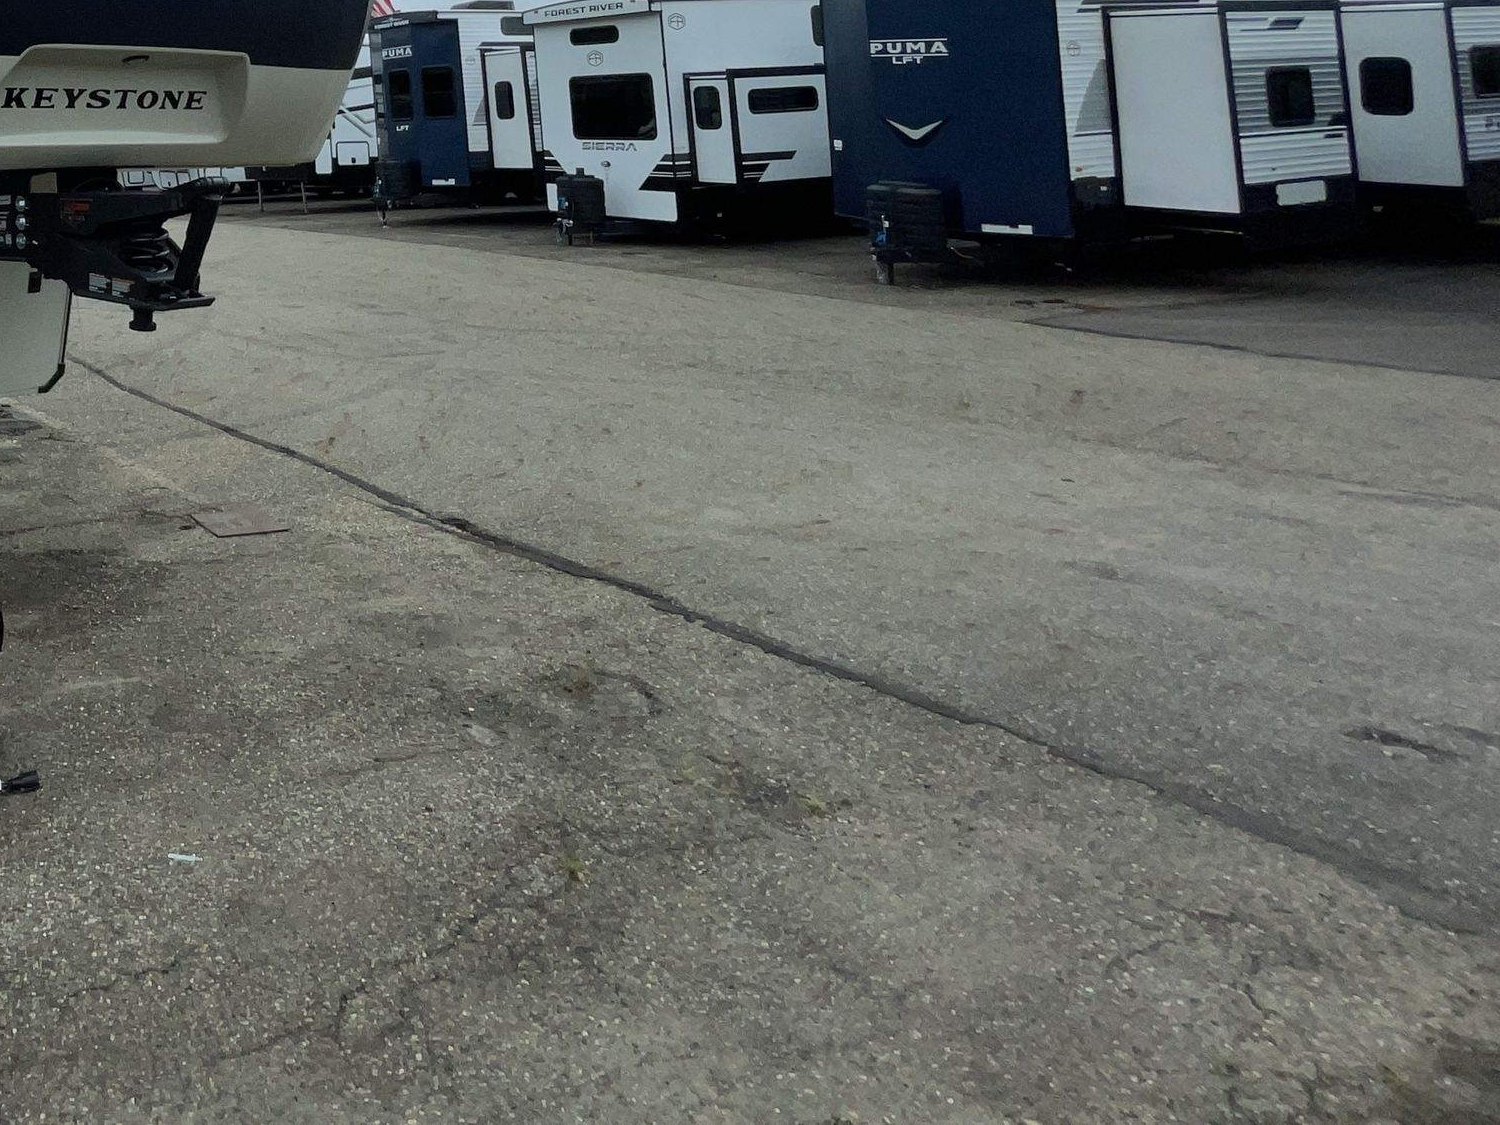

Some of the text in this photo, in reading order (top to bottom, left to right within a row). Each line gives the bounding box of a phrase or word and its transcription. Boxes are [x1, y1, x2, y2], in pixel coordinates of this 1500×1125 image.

[544, 2, 624, 17] FOREST RIVER
[382, 47, 412, 58] PUMA
[869, 41, 949, 54] PUMA
[892, 56, 924, 65] LFT
[1, 87, 208, 110] KEYSTONE
[396, 124, 410, 132] LFT
[581, 141, 638, 152] SIERRA
